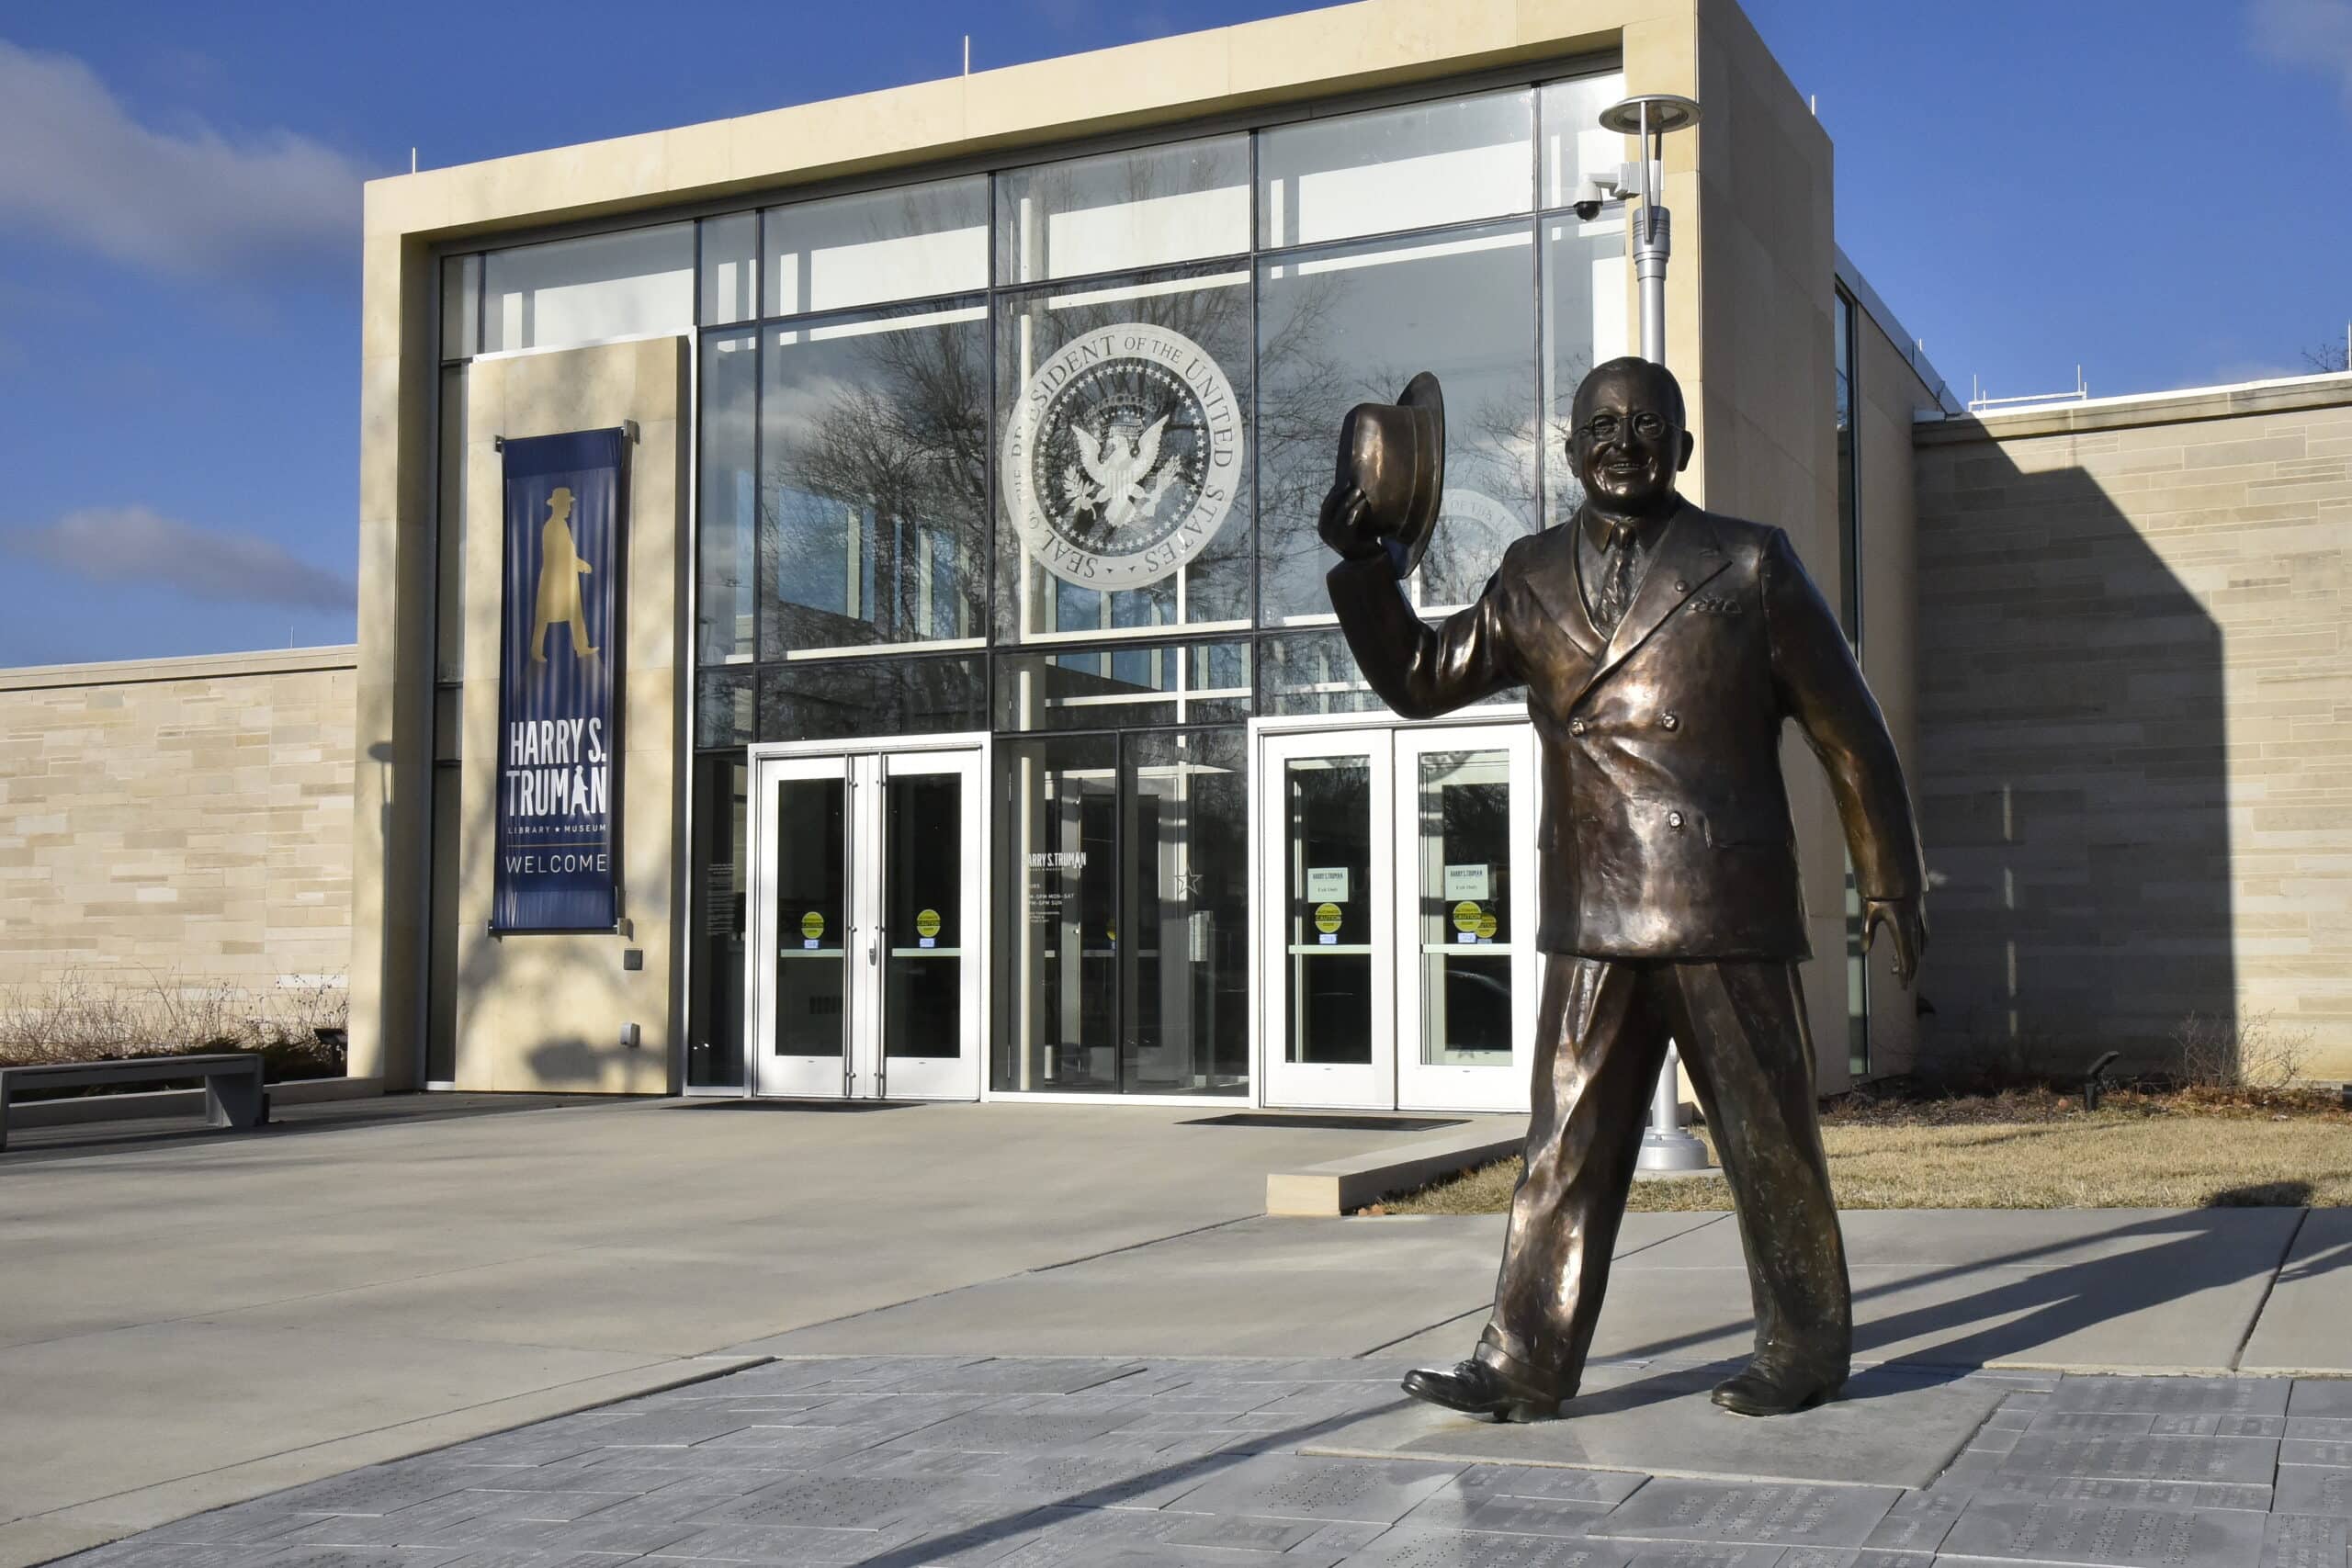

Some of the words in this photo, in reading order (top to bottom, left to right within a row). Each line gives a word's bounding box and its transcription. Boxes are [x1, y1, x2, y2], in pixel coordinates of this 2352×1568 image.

[1125, 336, 1148, 352] OF
[1152, 339, 1184, 363] THE
[1184, 357, 1233, 468] UNITED
[1144, 484, 1225, 573] STATES
[1043, 534, 1099, 579] SEAL
[510, 718, 583, 766] HARRY
[588, 716, 607, 763] S.
[506, 765, 607, 817] TRUMAN
[508, 826, 549, 835] LIBRARY
[564, 824, 606, 833] MUSEUM
[506, 853, 607, 874] WELCOME
